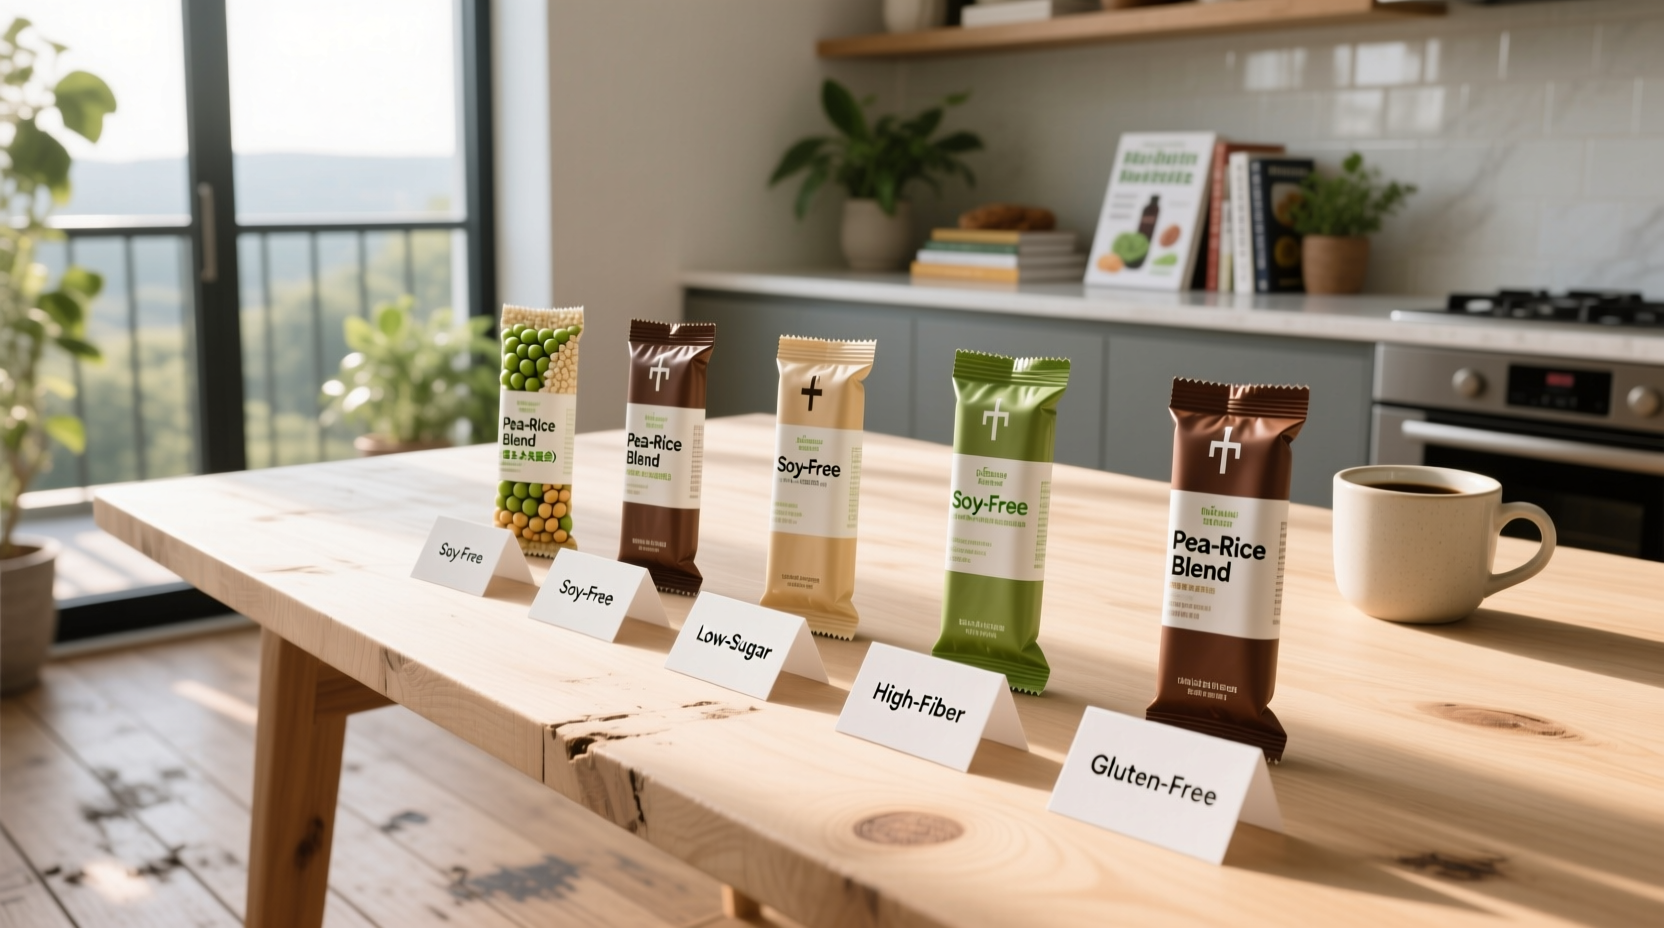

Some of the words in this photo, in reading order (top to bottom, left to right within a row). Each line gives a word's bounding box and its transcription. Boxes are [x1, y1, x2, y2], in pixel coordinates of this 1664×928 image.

[502, 433, 537, 448] Blend
[627, 431, 683, 453] Pea-Rice
[626, 449, 661, 468] Blend
[776, 455, 841, 479] Soy-Free
[951, 489, 1029, 517] Soy-Free
[1173, 529, 1267, 561] Pea-Rice
[1170, 555, 1232, 583] Blend
[558, 579, 614, 606] Soy-Free
[695, 624, 773, 661] Low-Sugar
[872, 681, 967, 724] High-Fiber
[1091, 754, 1218, 806] Gluten-Free
